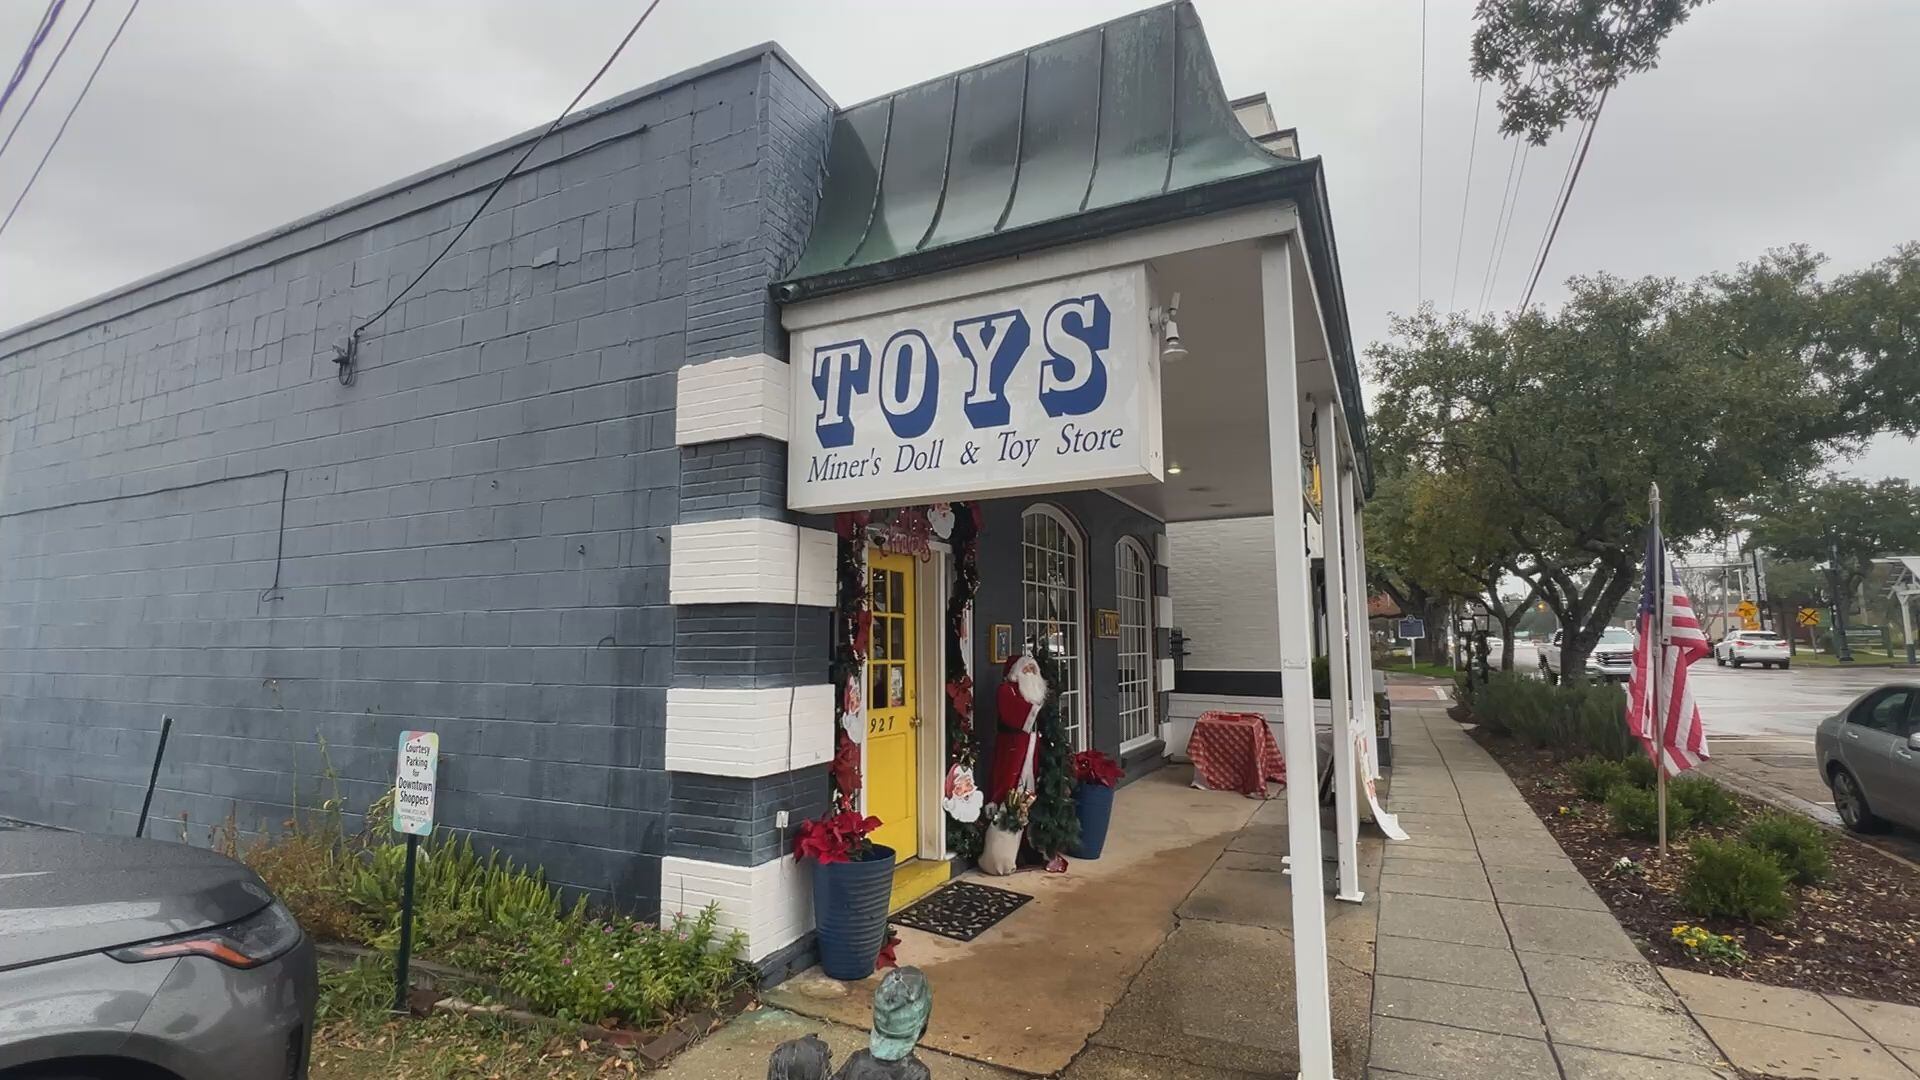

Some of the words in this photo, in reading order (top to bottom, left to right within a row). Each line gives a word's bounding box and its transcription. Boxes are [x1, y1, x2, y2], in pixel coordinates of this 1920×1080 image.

[812, 293, 1111, 449] TOYS
[807, 447, 881, 483] Miner's
[893, 438, 944, 473] Doll
[960, 440, 980, 465] &
[998, 430, 1040, 467] Toy
[1057, 423, 1123, 455] Store
[869, 716, 895, 733] 927
[405, 743, 430, 756] Courtesy
[406, 756, 428, 770] Parking
[398, 777, 432, 792] Downtown
[400, 791, 428, 806] Shoppers
